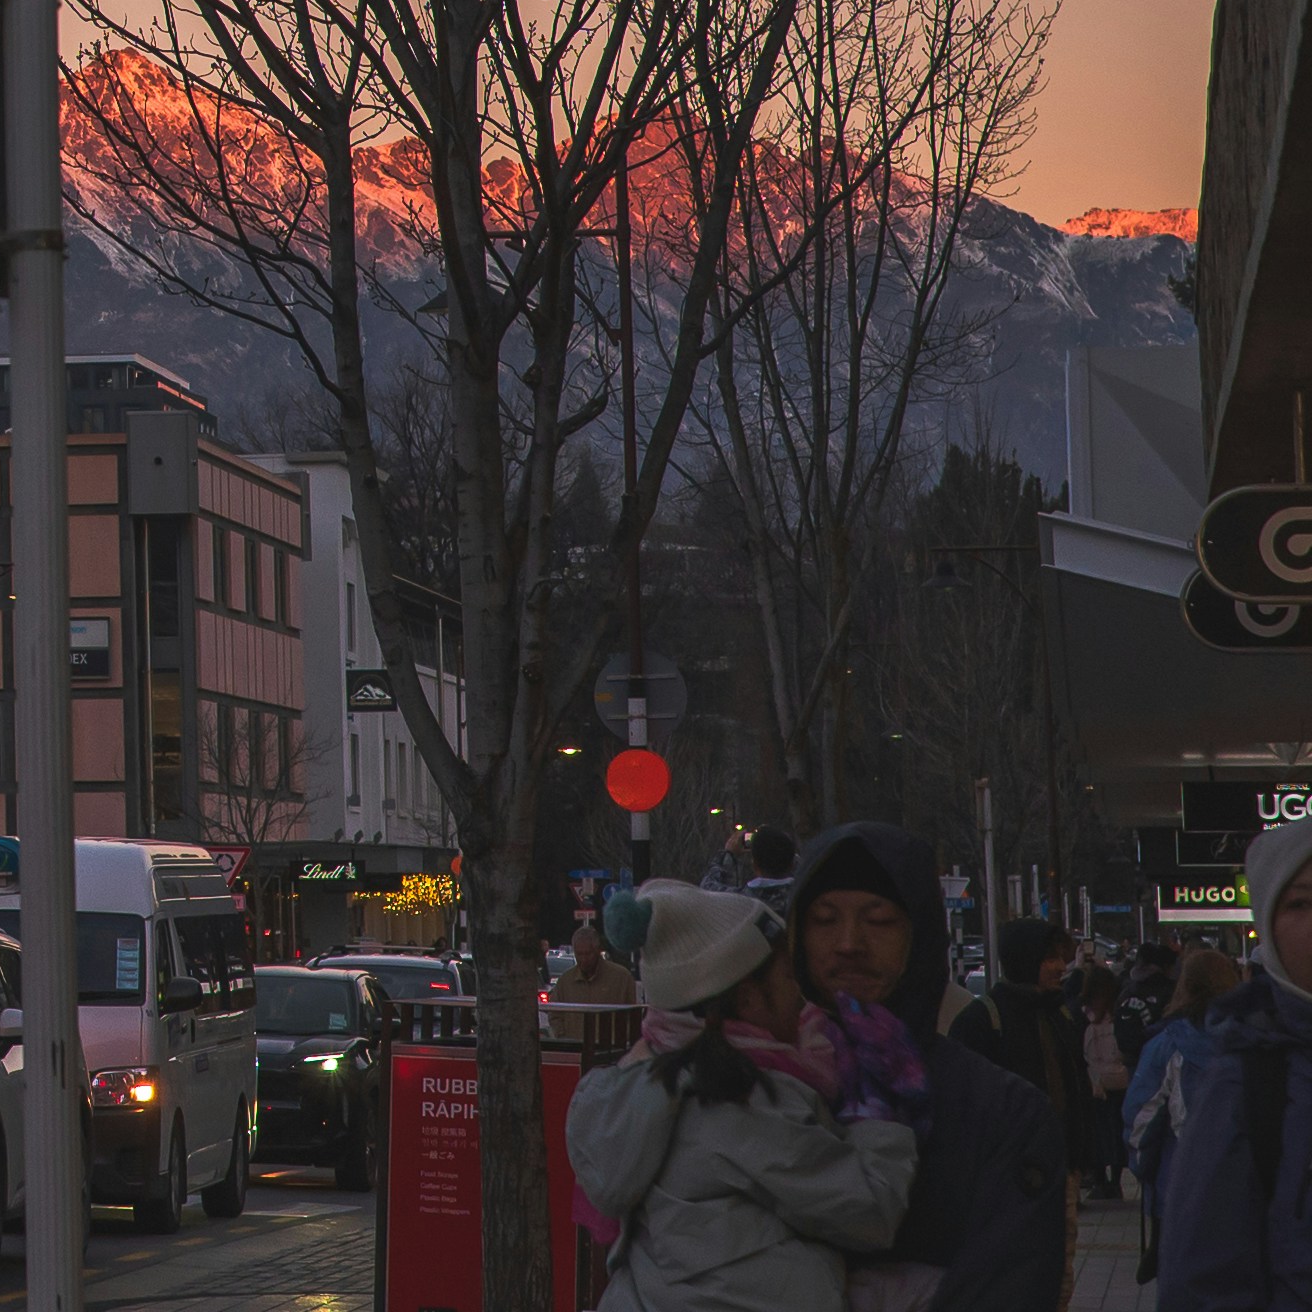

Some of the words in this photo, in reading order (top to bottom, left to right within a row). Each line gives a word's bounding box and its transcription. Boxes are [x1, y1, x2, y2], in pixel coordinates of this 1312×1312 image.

[1257, 793, 1312, 821] UG
[1174, 886, 1236, 903] HUGO
[422, 1077, 478, 1095] RUBB
